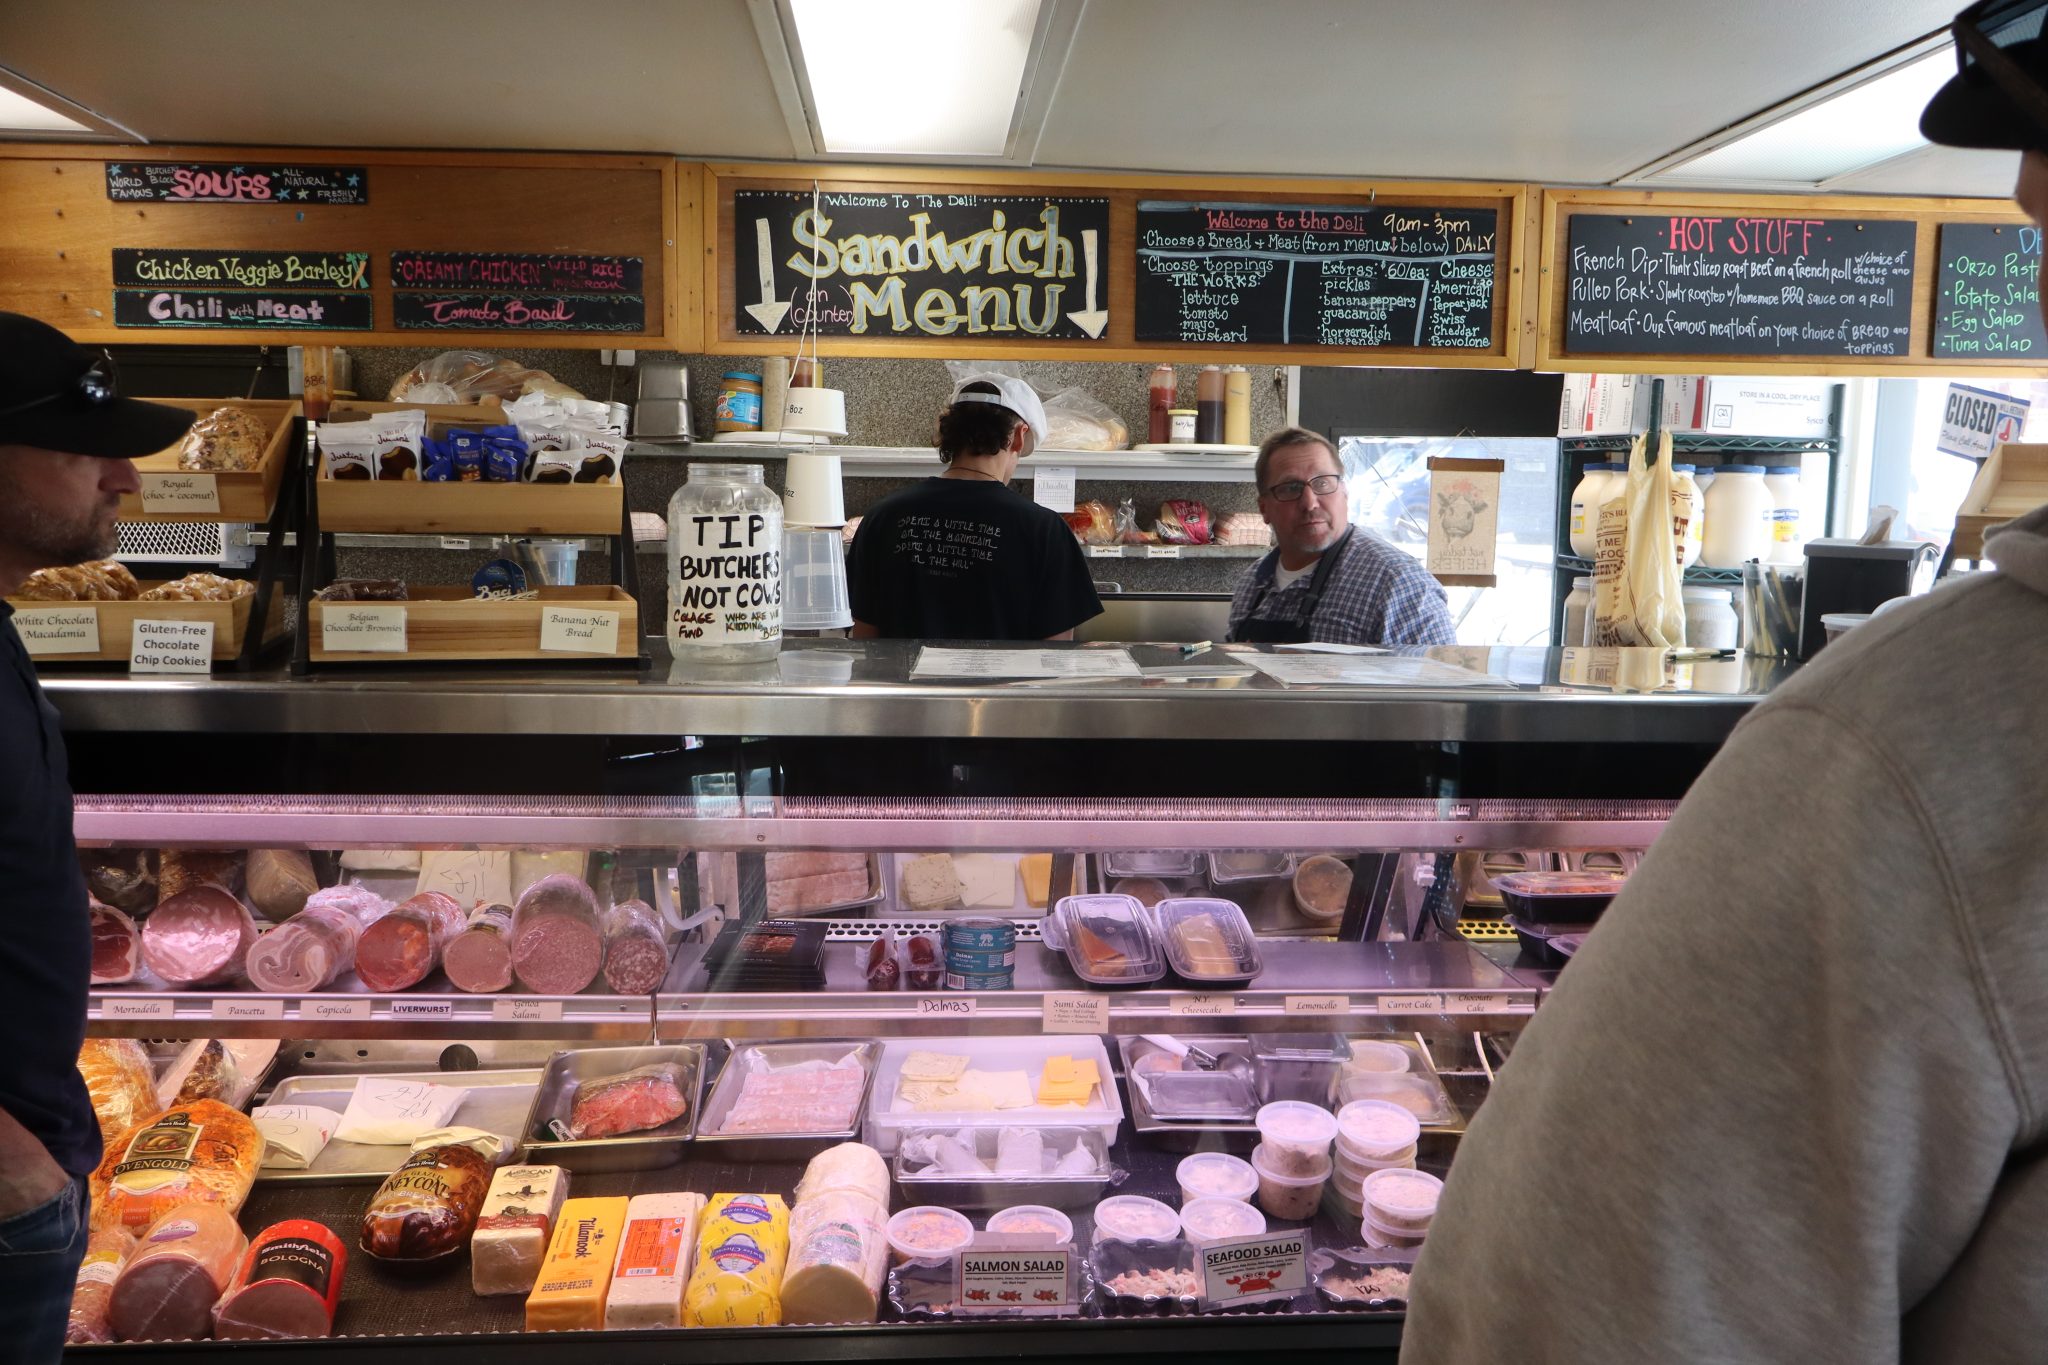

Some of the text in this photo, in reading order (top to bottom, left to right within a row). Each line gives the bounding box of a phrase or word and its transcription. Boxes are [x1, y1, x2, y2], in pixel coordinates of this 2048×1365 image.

[110, 177, 142, 187] WORLD
[171, 169, 272, 199] SOUPS
[285, 176, 328, 186] NATURAL
[111, 189, 153, 198] FAMOUS
[317, 190, 357, 198] FRESHLY
[826, 195, 977, 208] Welcome To The Deli!
[1207, 210, 1364, 231] Welcome to the Deli
[1384, 213, 1470, 238] 9am 3pm
[787, 206, 1075, 278] Sandwich
[1147, 230, 1449, 256] Choose a Bread Meat (from menus below)
[1670, 217, 1824, 256] HOT STUFF
[1895, 251, 1908, 264] of
[136, 256, 353, 288] Chicken Veggie Barley
[402, 260, 624, 284] CREAMY CHICKEN RICE
[1148, 256, 1273, 277] Choose toppings
[1322, 261, 1377, 277] Extras:
[1440, 259, 1494, 278] Cheese:
[1632, 247, 1658, 285] Dip
[1774, 268, 1785, 277] on
[1853, 265, 1887, 275] cheese
[1325, 279, 1370, 294] pickles
[1433, 281, 1490, 297] American
[1182, 288, 1239, 305] lettuce
[1324, 295, 1416, 311] banana peppers
[1781, 286, 1866, 306] BBQ sauce on a
[1955, 280, 2000, 311] Potato
[148, 293, 324, 320] Chili with Meat
[424, 300, 575, 324] Tomato Basil
[850, 276, 1065, 334] Menu
[1183, 306, 1228, 320] tomato
[1324, 309, 1387, 324] guacamole
[1432, 313, 1466, 324] Swiss
[1183, 320, 1215, 332] mayo
[1571, 309, 1850, 341] Meatloaf meatloaf on choice of
[1952, 310, 1977, 332] Egg
[1182, 326, 1247, 342] mustard
[1322, 324, 1391, 340] horseradish
[1434, 324, 1479, 336] Cheddar
[1432, 336, 1490, 347] Provolone
[1944, 335, 1979, 352] Tuna
[1806, 416, 1824, 424] Sysco
[1945, 393, 1997, 435] CLOSED
[532, 432, 562, 445] Justin's
[585, 438, 617, 454] Justin's
[330, 451, 365, 462] Justin's
[161, 479, 193, 491] Royale
[143, 491, 214, 500] (choc coconut)
[693, 515, 764, 549] TIP
[945, 520, 1001, 537] LITTLE TIME
[923, 530, 998, 549] THE MOUNTAIN
[937, 544, 993, 561] LITTLE TIME
[680, 551, 780, 580] BUTCHERS
[929, 555, 948, 566] THE
[475, 585, 512, 599] Baci
[682, 581, 781, 609] NOT COWS
[14, 615, 94, 626] White Chocolate
[348, 613, 379, 623] Belgian
[550, 614, 610, 627] Banana Nut
[751, 612, 766, 621] ARE
[25, 629, 86, 639] Macadamia
[139, 624, 206, 635] Gluten-Free
[324, 624, 402, 633] Chocolate Brownies
[566, 627, 593, 638] Bread
[144, 640, 200, 650] Chocolate
[134, 655, 206, 666] Chip Cookies
[113, 1003, 352, 1017] Mortadella Pancetta Capicola
[393, 1005, 450, 1014] LIVERWURST
[922, 999, 970, 1013] Dolmas
[1053, 1000, 1098, 1009] Sumi Salad
[1182, 1006, 1222, 1014] Cheesecake
[1296, 1002, 1337, 1010] Lemoncello
[1388, 1001, 1432, 1009] Carrot Cake
[1467, 1005, 1485, 1013] Cake
[511, 1011, 541, 1020] Salami
[115, 1159, 190, 1174] OVENGOLD
[414, 1177, 449, 1196] COAT
[575, 1218, 597, 1258] Tillamook
[260, 1242, 328, 1259] Smithfield
[1207, 1242, 1301, 1264] SEAFOOD SALAD
[260, 1255, 325, 1274] BOLOGNA
[965, 1260, 1064, 1272] SALMON SALAD
